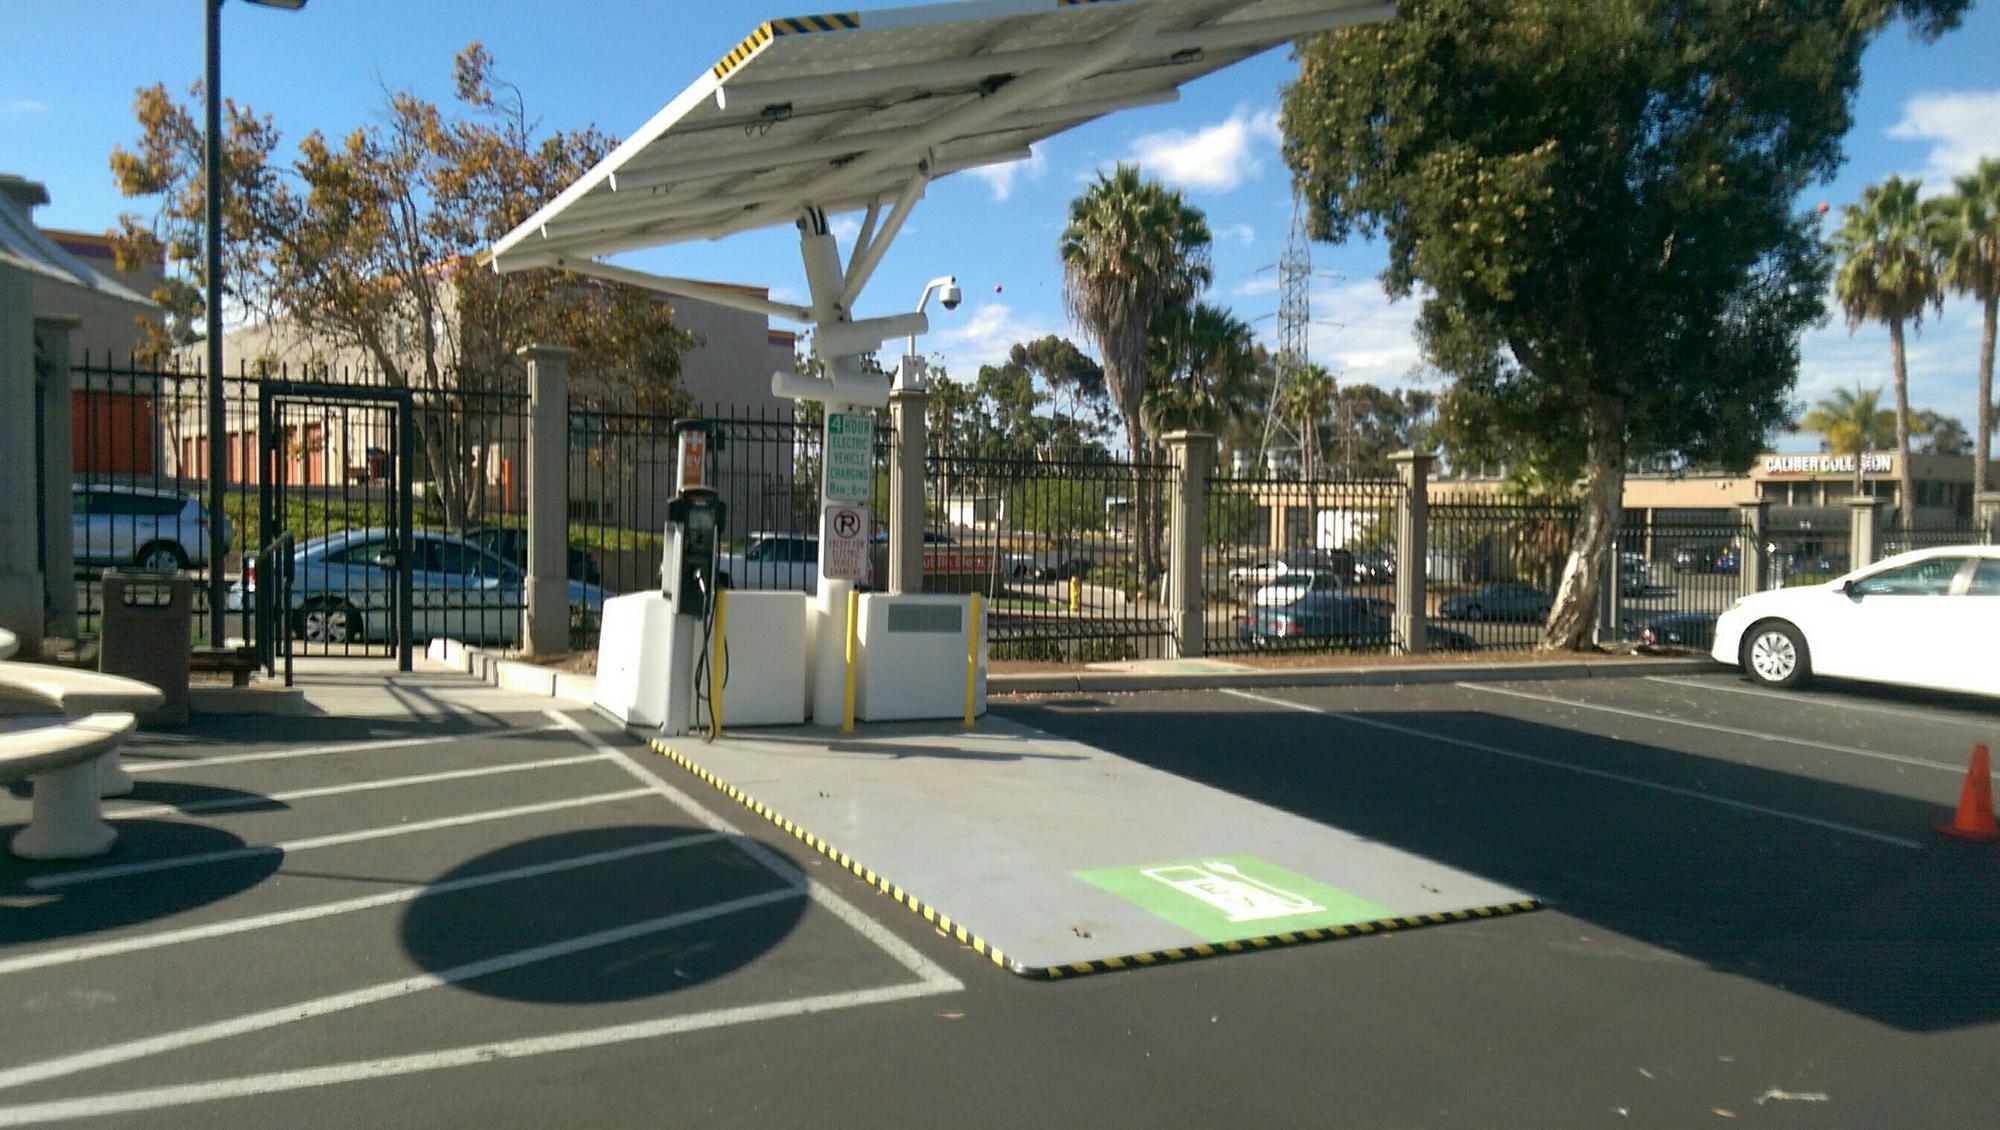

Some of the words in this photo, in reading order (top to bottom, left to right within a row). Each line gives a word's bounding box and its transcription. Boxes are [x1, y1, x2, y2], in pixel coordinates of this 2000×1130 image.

[844, 418, 869, 433] HOUR
[832, 436, 867, 449] ELECTRIC
[834, 453, 865, 465] VEHICLE
[1766, 456, 1818, 472] CALIBER
[830, 468, 867, 480] CHARGING
